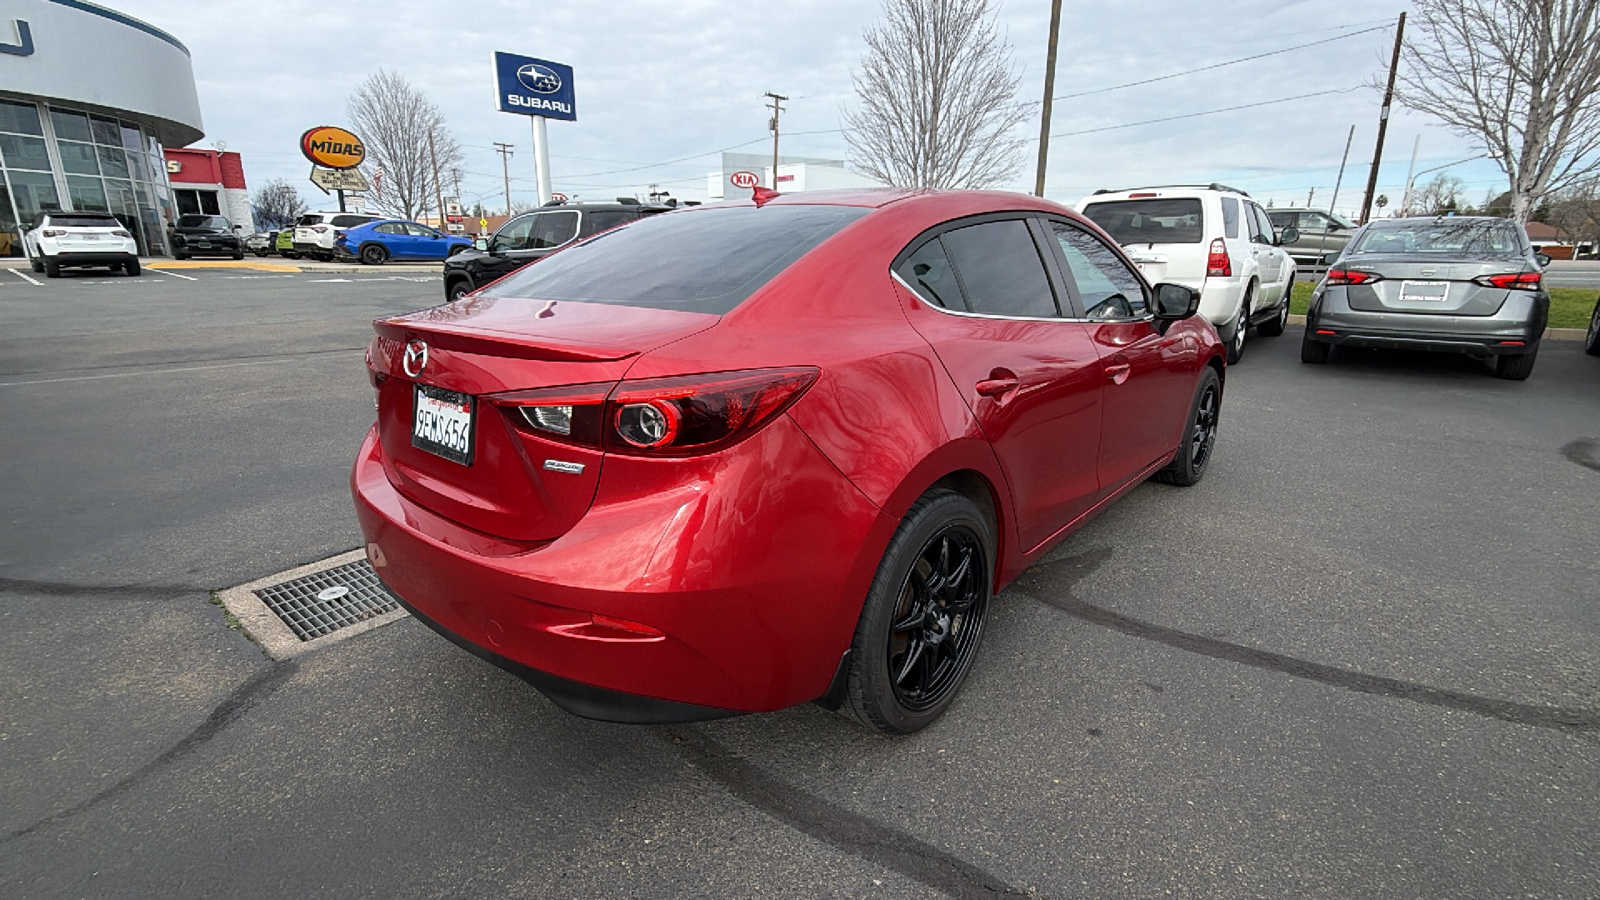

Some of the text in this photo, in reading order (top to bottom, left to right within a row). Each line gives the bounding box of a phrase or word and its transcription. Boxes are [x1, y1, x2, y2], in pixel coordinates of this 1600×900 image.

[507, 94, 571, 114] SUBARU
[311, 136, 363, 156] MIDAS
[736, 175, 754, 184] KIA
[417, 409, 469, 451] 9EMS656
